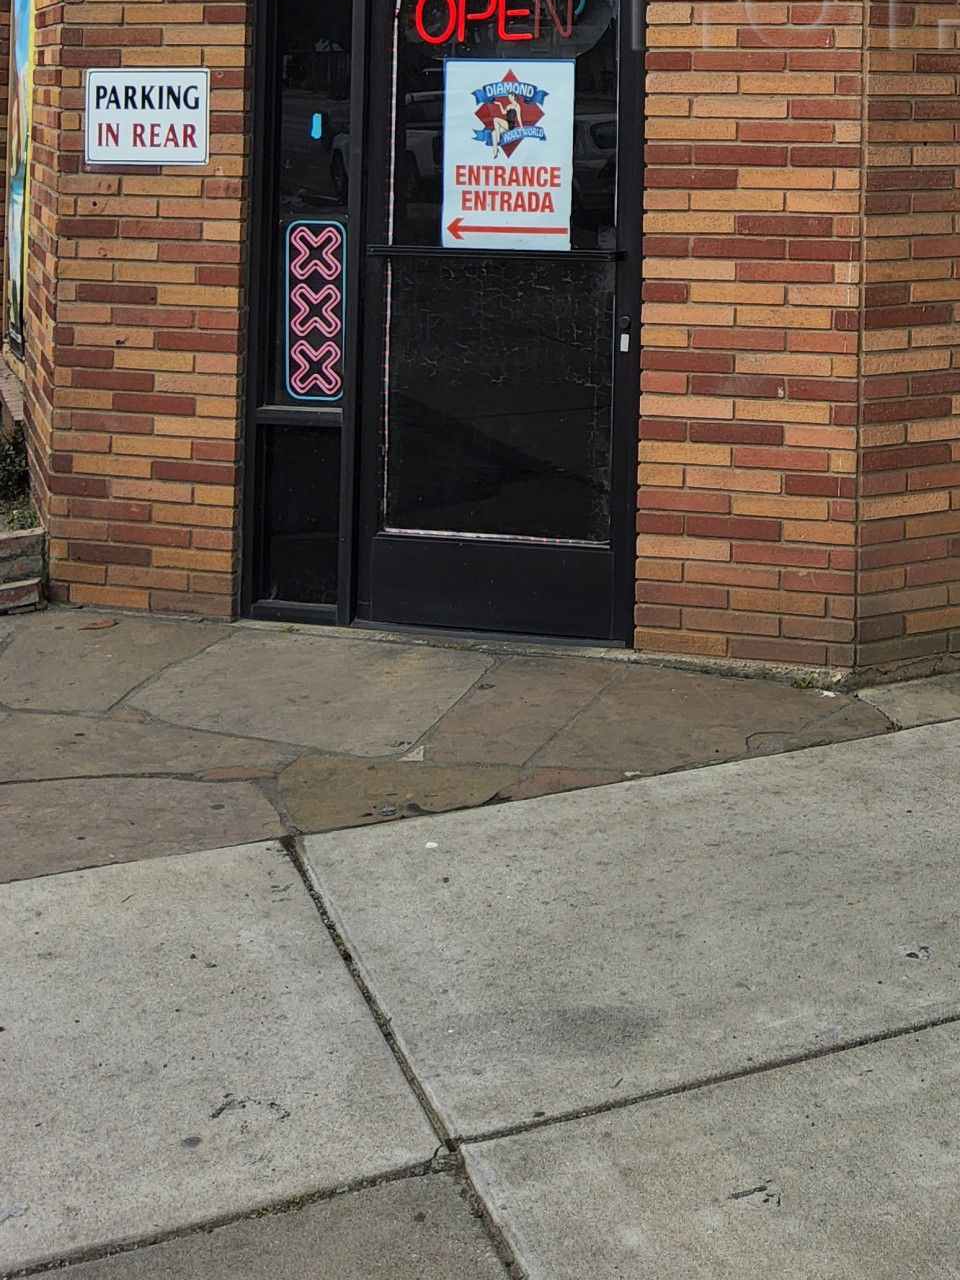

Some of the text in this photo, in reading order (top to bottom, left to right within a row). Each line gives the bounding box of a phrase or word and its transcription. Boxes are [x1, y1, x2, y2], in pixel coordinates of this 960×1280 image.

[95, 84, 200, 111] PARKING
[485, 83, 535, 98] DIAMOND
[96, 122, 198, 149] IN REAR
[455, 165, 561, 188] ENTRANCE
[461, 190, 555, 213] ENTRADA
